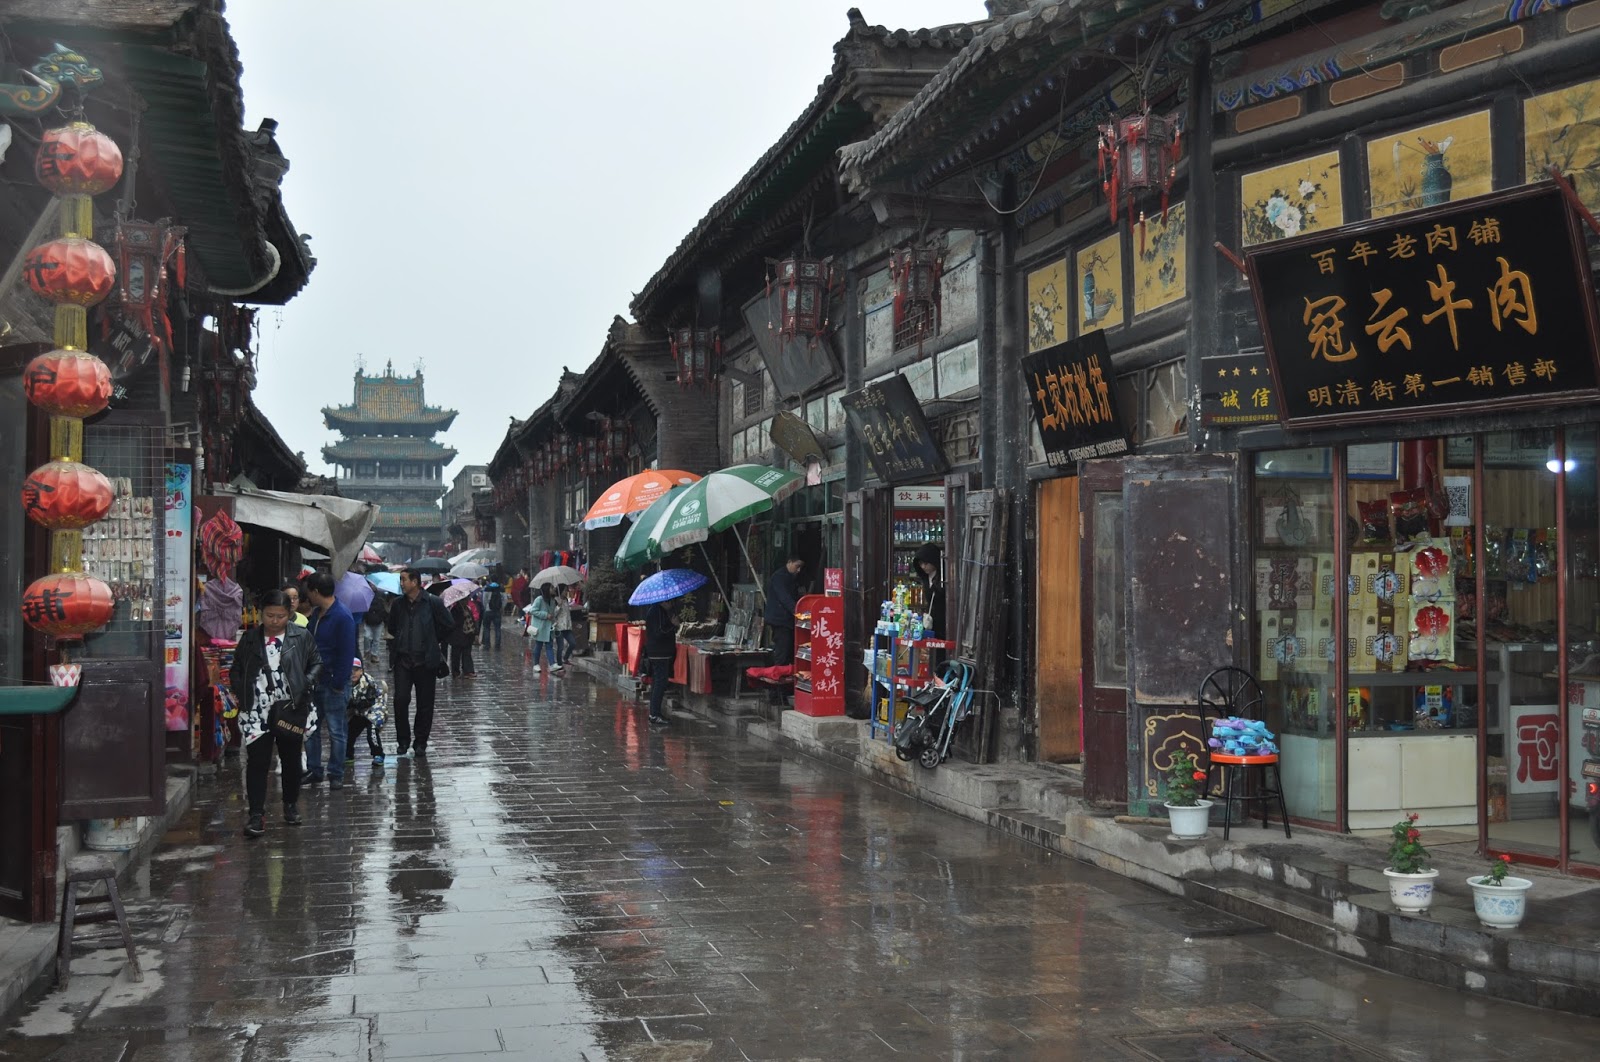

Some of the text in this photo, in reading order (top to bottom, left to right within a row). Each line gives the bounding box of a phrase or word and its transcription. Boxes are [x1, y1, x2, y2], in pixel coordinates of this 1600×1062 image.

[1311, 217, 1501, 274] 百年老肉铺
[1303, 256, 1537, 362] 冠云牛肉
[1220, 388, 1271, 410] 诚信
[1307, 358, 1557, 408] 明清街第一销售部
[1516, 713, 1559, 783] 冠
